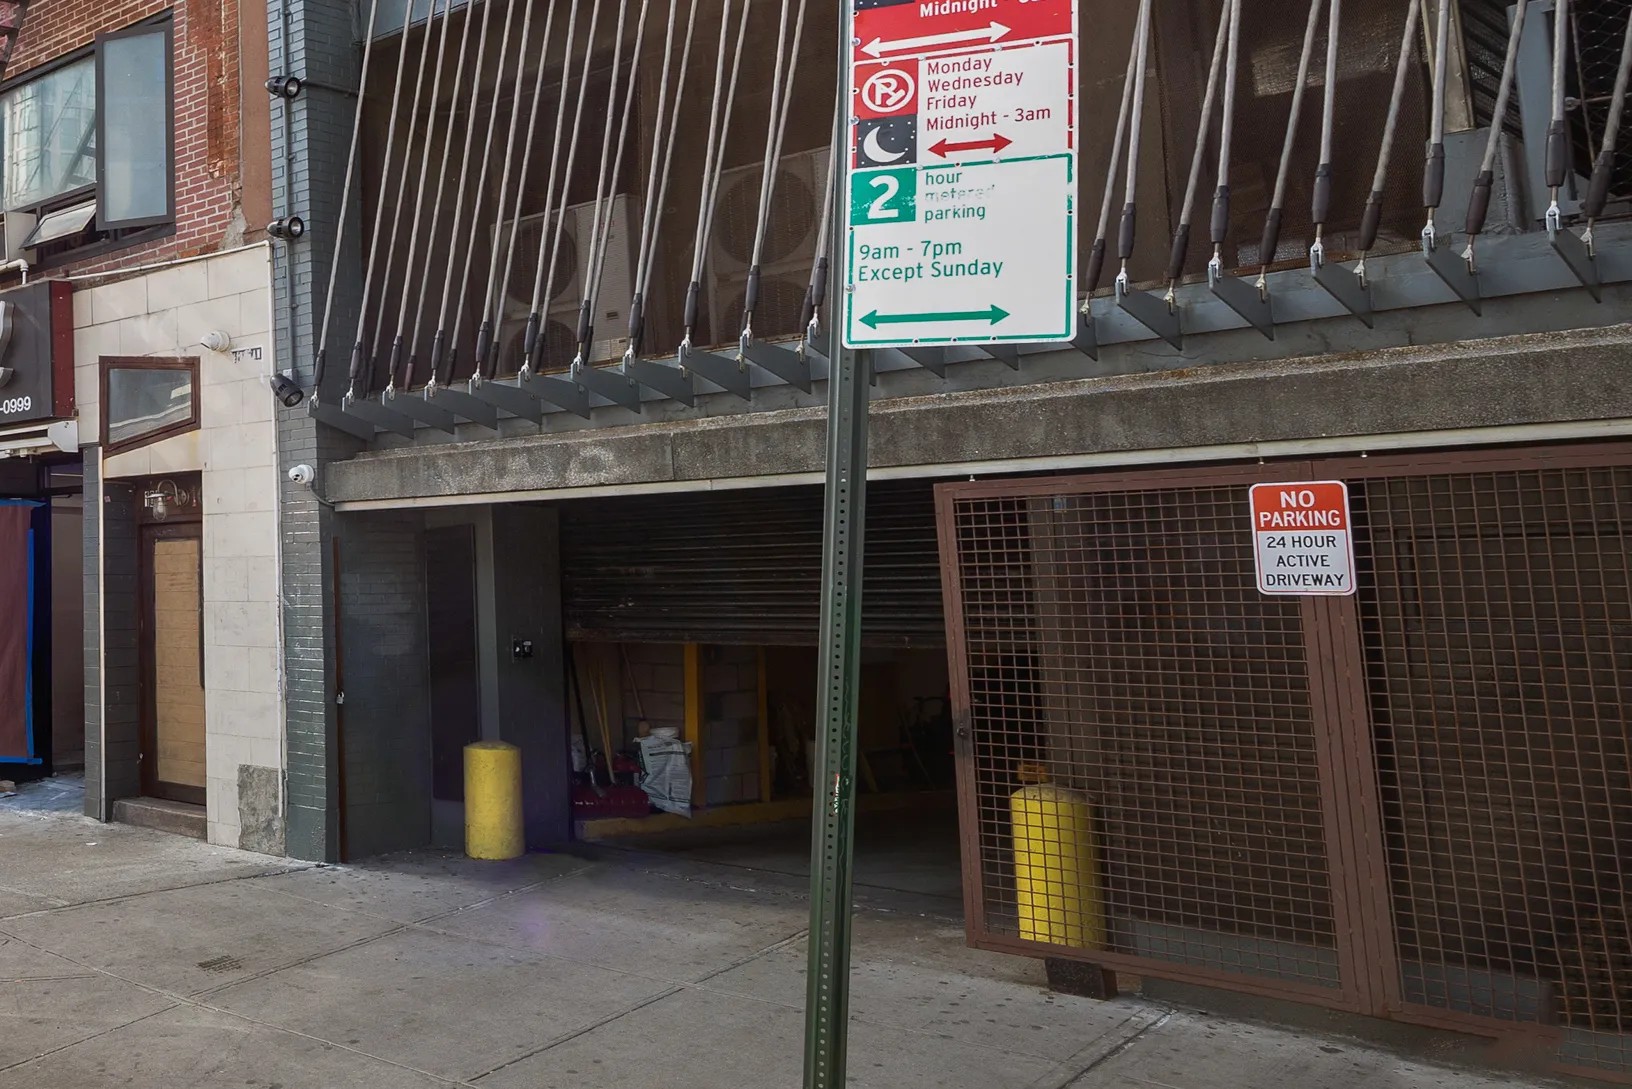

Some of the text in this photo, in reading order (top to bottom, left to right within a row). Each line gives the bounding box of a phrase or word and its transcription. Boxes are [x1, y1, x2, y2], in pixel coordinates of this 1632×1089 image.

[927, 58, 992, 76] Monday
[927, 71, 1024, 93] Wednesday
[926, 94, 977, 110] Friday
[926, 111, 997, 131] Midnight
[1014, 108, 1051, 123] 3am
[925, 171, 963, 185] hour
[867, 174, 900, 219] 2
[924, 204, 986, 223] parking
[859, 244, 899, 260] 9am
[920, 240, 962, 259] 7pm
[858, 259, 1003, 282] Except Sunday
[1280, 490, 1315, 508] NO
[1259, 509, 1341, 527] PARKING
[1266, 535, 1337, 548] 24 HOUR
[1276, 554, 1331, 567] ACTIVE
[1266, 573, 1344, 586] DRIVEWAY
